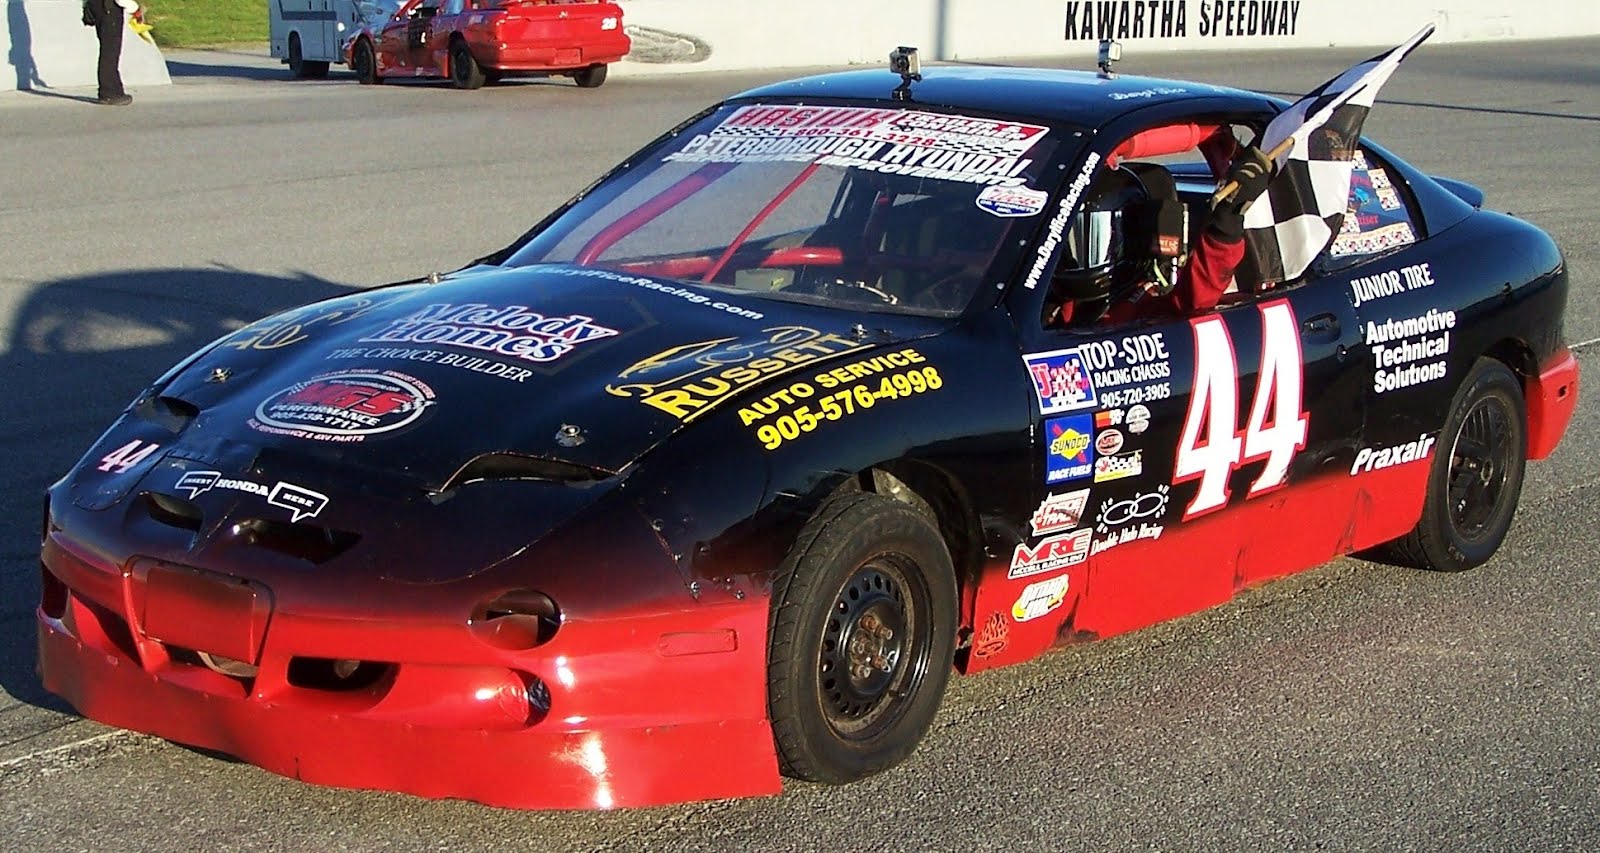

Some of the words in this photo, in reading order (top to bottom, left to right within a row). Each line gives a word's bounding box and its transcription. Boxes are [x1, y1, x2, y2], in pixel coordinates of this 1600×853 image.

[1064, 0, 1187, 40] KAWARTHA
[1199, 0, 1300, 37] SPEEDWAY
[896, 120, 1028, 140] CONTAINER
[903, 112, 995, 130] TRAILER
[680, 134, 881, 160] PETERBOROUGH
[879, 142, 1033, 178] HYUNDAI
[1350, 269, 1405, 308] JUNIOR
[1401, 263, 1435, 291] TIRE
[358, 321, 575, 362] Homes
[396, 303, 619, 344] Melody
[1365, 308, 1456, 345] Automotive
[324, 347, 363, 361] THE
[362, 346, 442, 363] CHOICE
[437, 352, 534, 383] BUILDER
[1078, 332, 1170, 371] TOP-SIDE
[1371, 331, 1450, 369] Technical
[641, 334, 864, 420] RUSSETT
[737, 382, 815, 427] AUTO
[814, 348, 927, 389] SERVICE
[1094, 369, 1132, 389] RACING
[1131, 360, 1171, 383] CHASSIS
[1373, 360, 1447, 394] Solutions
[756, 366, 944, 451] 905-576-4998
[1101, 382, 1171, 409] 905-720-3905
[1171, 297, 1311, 523] 44
[269, 404, 382, 427] PERFORMANCE
[98, 439, 160, 474] 44
[330, 433, 365, 443] PARTS
[1052, 434, 1090, 453] SUNOCO
[1350, 433, 1435, 476] Praxair
[215, 477, 270, 497] HONDA
[1048, 467, 1071, 481] RACE
[1069, 464, 1092, 477] FUELS
